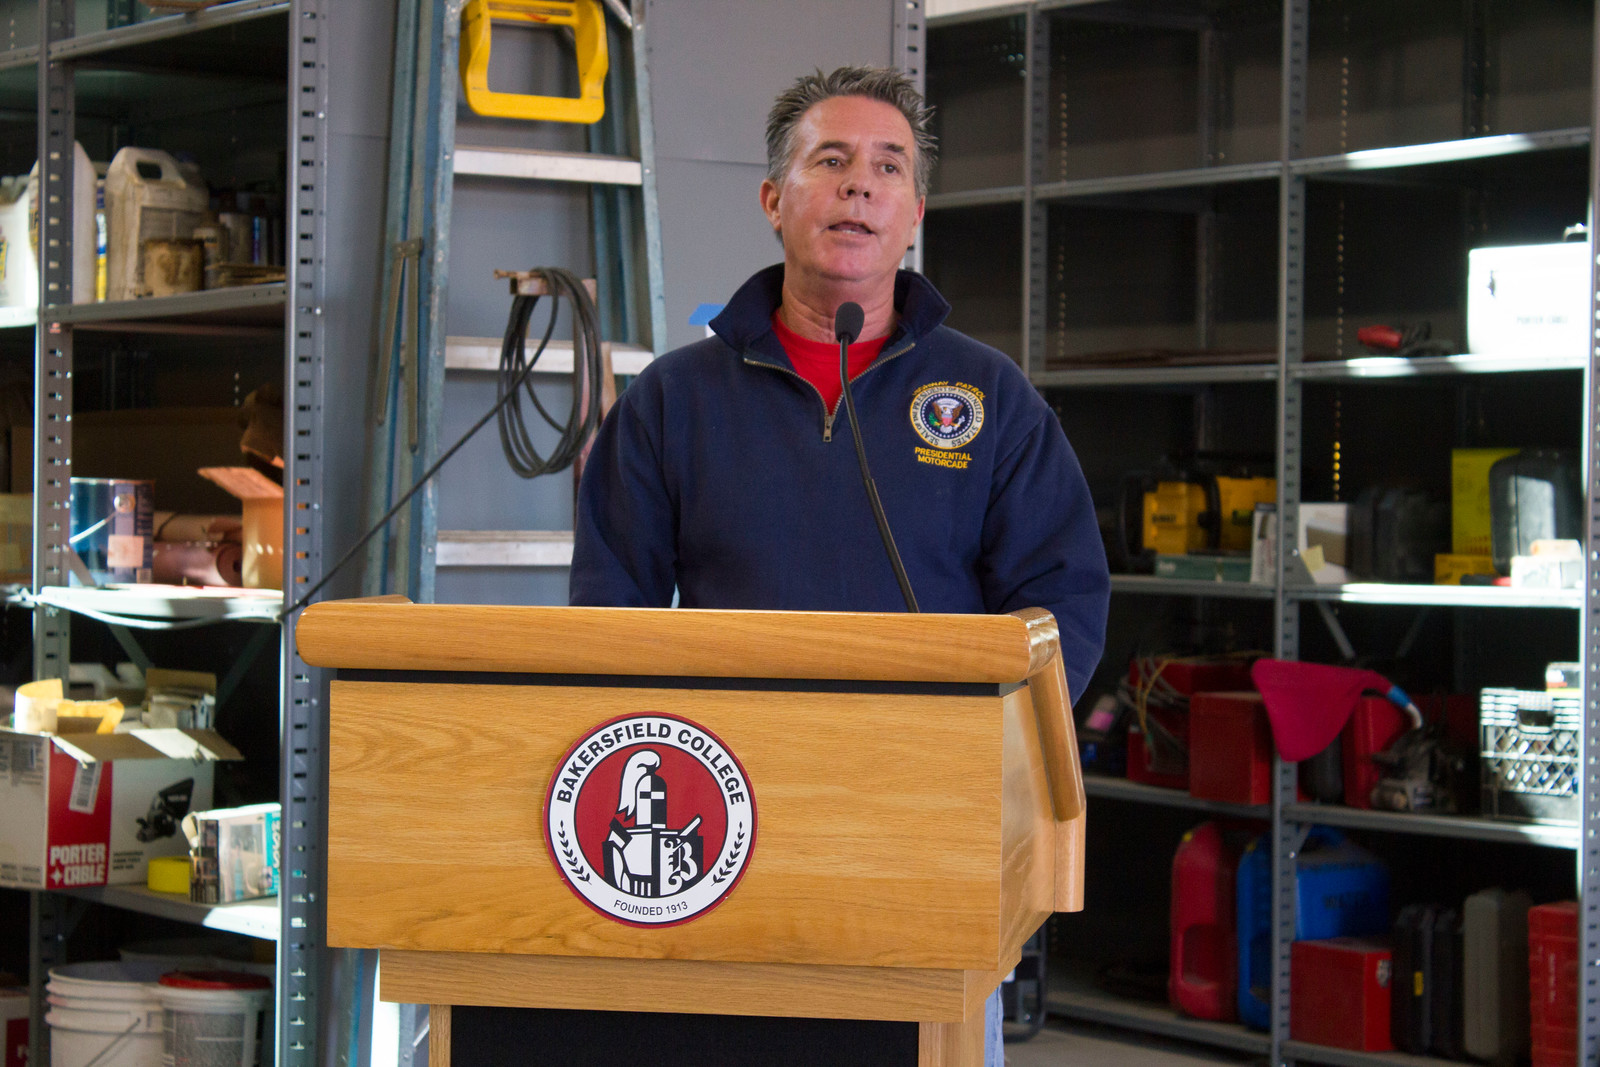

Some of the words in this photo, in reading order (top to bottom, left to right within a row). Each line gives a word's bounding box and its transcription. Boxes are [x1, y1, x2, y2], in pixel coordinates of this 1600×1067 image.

[955, 382, 986, 401] PATROL
[914, 446, 972, 461] PRESIDENTIAL
[917, 454, 968, 469] MOTORCADE
[556, 722, 672, 804] BAKERSFIELD
[677, 729, 745, 805] COLLEGE
[50, 843, 105, 866] PORTER
[63, 864, 104, 885] CABLE
[613, 899, 663, 916] FOUNDED
[665, 901, 689, 915] 1913
